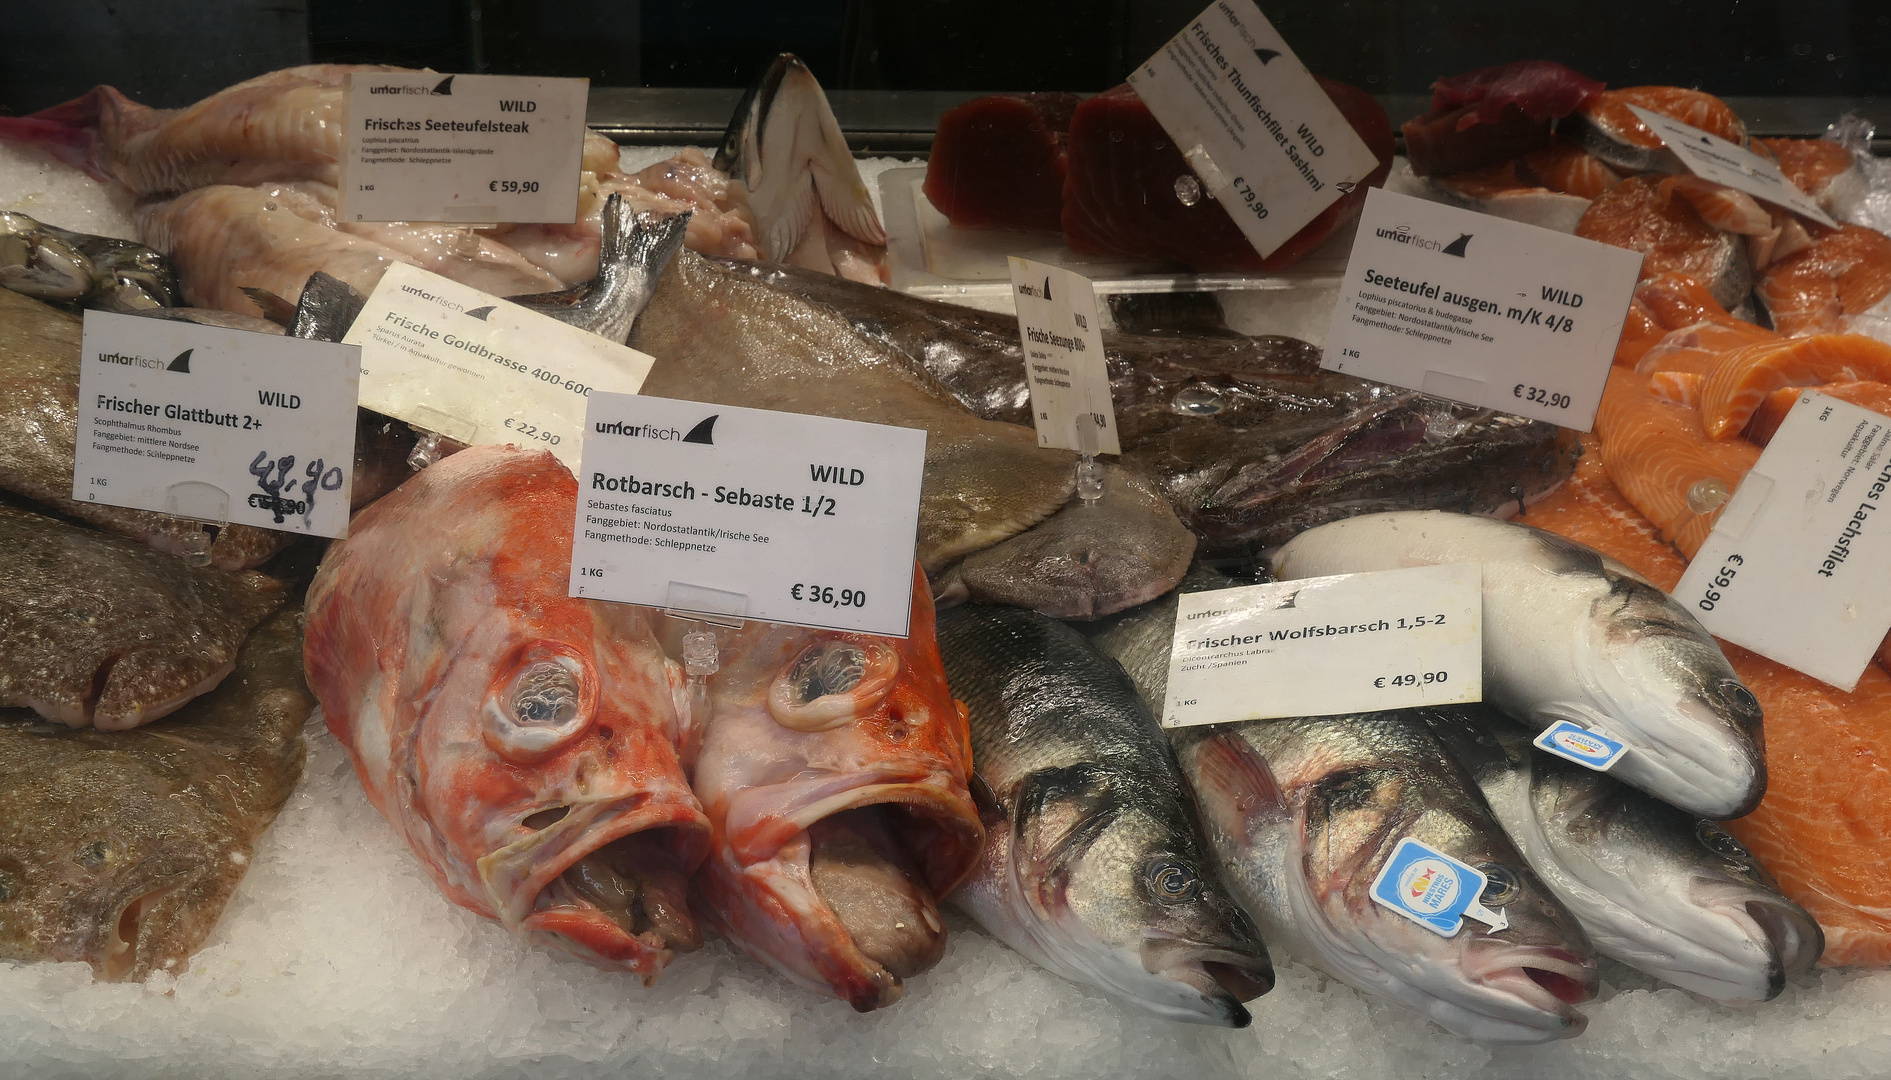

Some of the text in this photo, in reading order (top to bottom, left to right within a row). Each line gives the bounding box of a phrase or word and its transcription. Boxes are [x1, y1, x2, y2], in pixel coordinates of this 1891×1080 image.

[370, 85, 429, 95] umarfisch
[499, 100, 536, 113] WILD
[1191, 22, 1325, 192] Frisches Thunfischfilet Sashimi
[365, 118, 529, 133] Frisches Seeteufelsteak
[1297, 123, 1324, 157] WILD
[489, 180, 539, 194] € 59,90
[1233, 177, 1268, 219] € 79,90
[402, 285, 463, 312] umarfisch
[1358, 290, 1473, 325] Lophius piscatorius & budegasse
[1364, 269, 1573, 333] Seeteufel ausgen. m/K 4/8
[1542, 286, 1583, 308] WILD
[1074, 313, 1087, 329] WILD
[1352, 314, 1452, 345] Fangmethode: Schleppnetze
[1355, 302, 1395, 318] Fanggebiet:
[1481, 333, 1494, 343] See
[376, 326, 425, 348] Sparus Aurata
[385, 312, 439, 339] Frische
[443, 334, 528, 373] Goldbrasse
[1027, 327, 1049, 344] Frische
[1049, 331, 1074, 352] Seezunge
[99, 352, 164, 369] umarfisch
[408, 348, 446, 365] Aquakultur
[447, 364, 485, 380] gewonnen
[1343, 348, 1360, 358] 1 KG
[258, 390, 301, 409] WILD
[1513, 384, 1571, 409] € 32,90
[97, 395, 262, 430] Frischer Glattbutt 2+
[94, 417, 181, 436] Scophthalmus Rhombus
[504, 418, 561, 445] € 22,90
[596, 421, 680, 441] umarfisch
[1840, 419, 1869, 459] Aquakultur
[92, 442, 195, 463] Fangmethode: Schleppnetze
[93, 429, 199, 451] Fanggebiet: mittlere Nordsee
[810, 464, 864, 486] WILD
[1827, 424, 1882, 503] Fanggebiet: Norwegen
[97, 478, 107, 486] KG
[592, 472, 695, 500] Rotbarsch
[714, 486, 794, 511] Sebaste
[801, 495, 836, 517] 1/2
[587, 499, 672, 517] Sebastes fasciatus
[585, 530, 652, 545] Fangmethode:
[586, 515, 769, 543] Fanggebiet: Nordostatlantik/Irische See
[1818, 503, 1876, 577] Lachsfilet
[581, 567, 603, 577] 1 KG
[1699, 554, 1743, 611] € 59,90
[791, 583, 866, 608] € 36,90
[1188, 614, 1446, 649] Frischer Wolfsbarsch 1,5-2
[1373, 671, 1448, 688] € 49,90
[1421, 872, 1445, 904] NUESTROS
[1429, 876, 1454, 909] MARES
